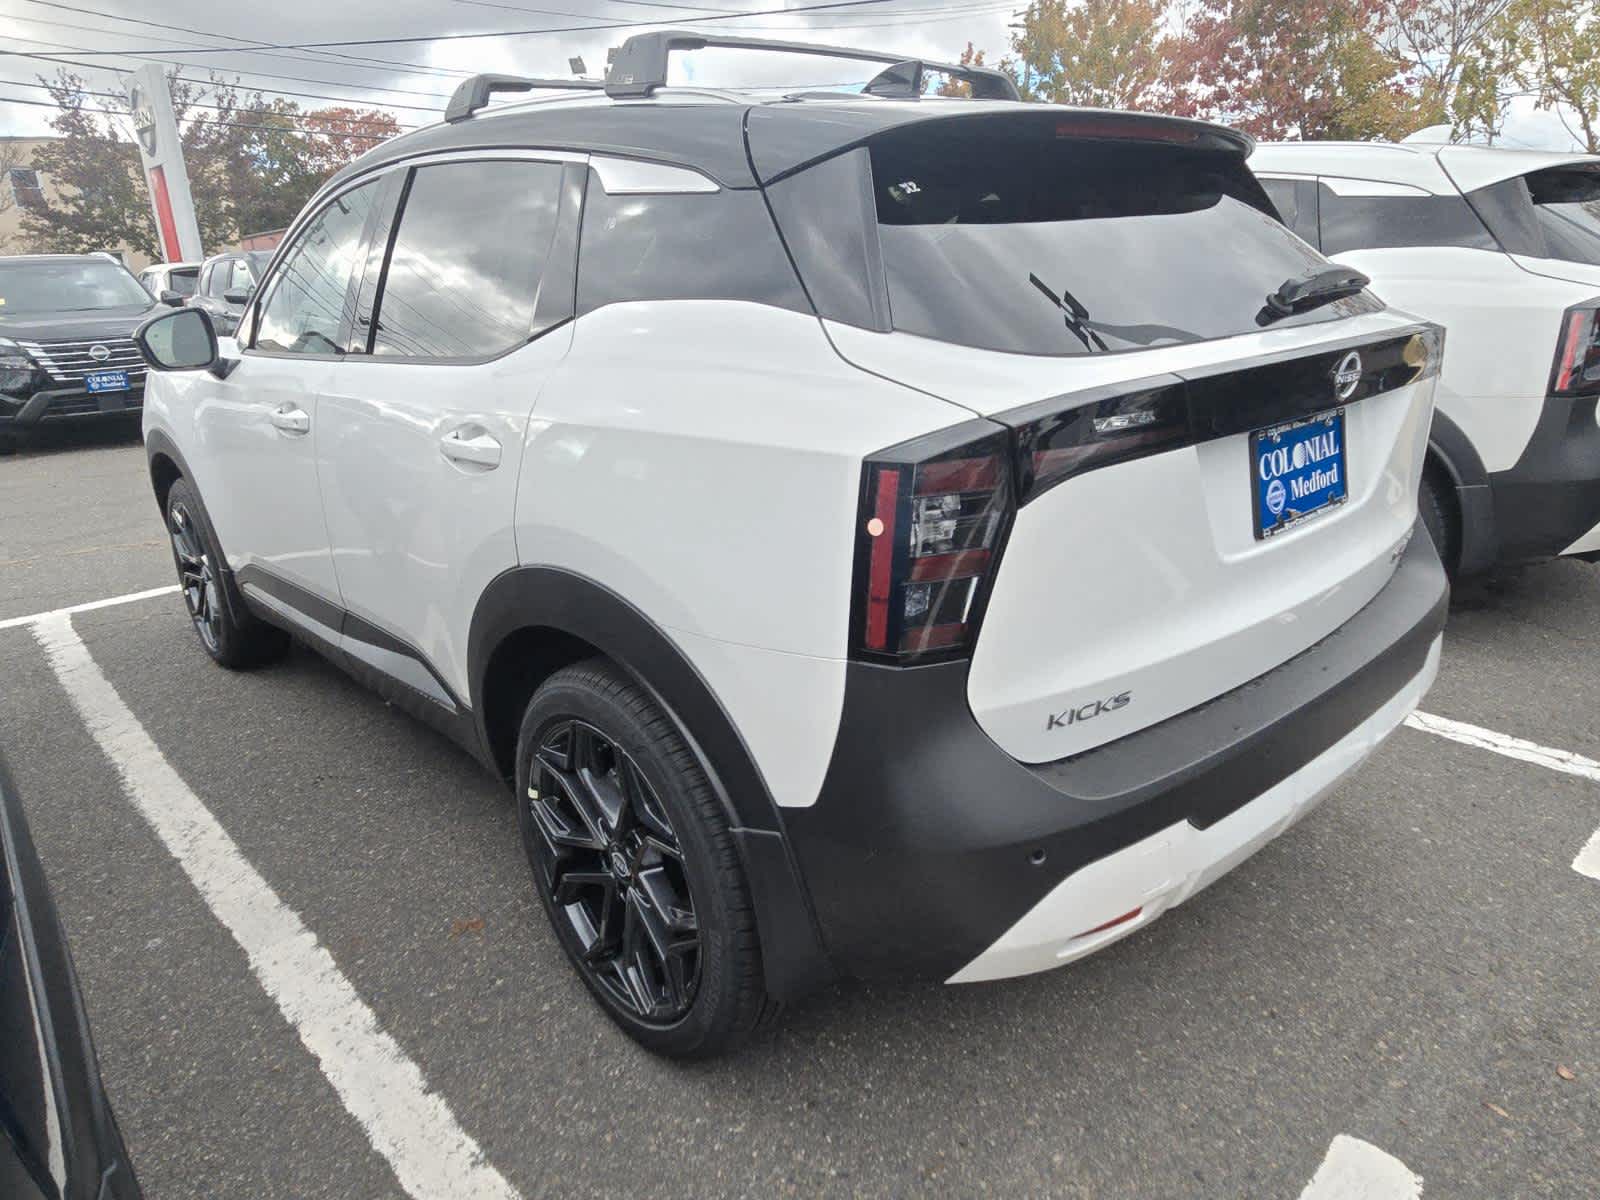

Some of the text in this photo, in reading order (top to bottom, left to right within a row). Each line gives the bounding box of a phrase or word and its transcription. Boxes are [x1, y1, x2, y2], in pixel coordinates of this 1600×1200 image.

[1260, 431, 1339, 480] COLONIAL
[1290, 463, 1338, 500] Medford
[1047, 690, 1132, 730] KICKS
